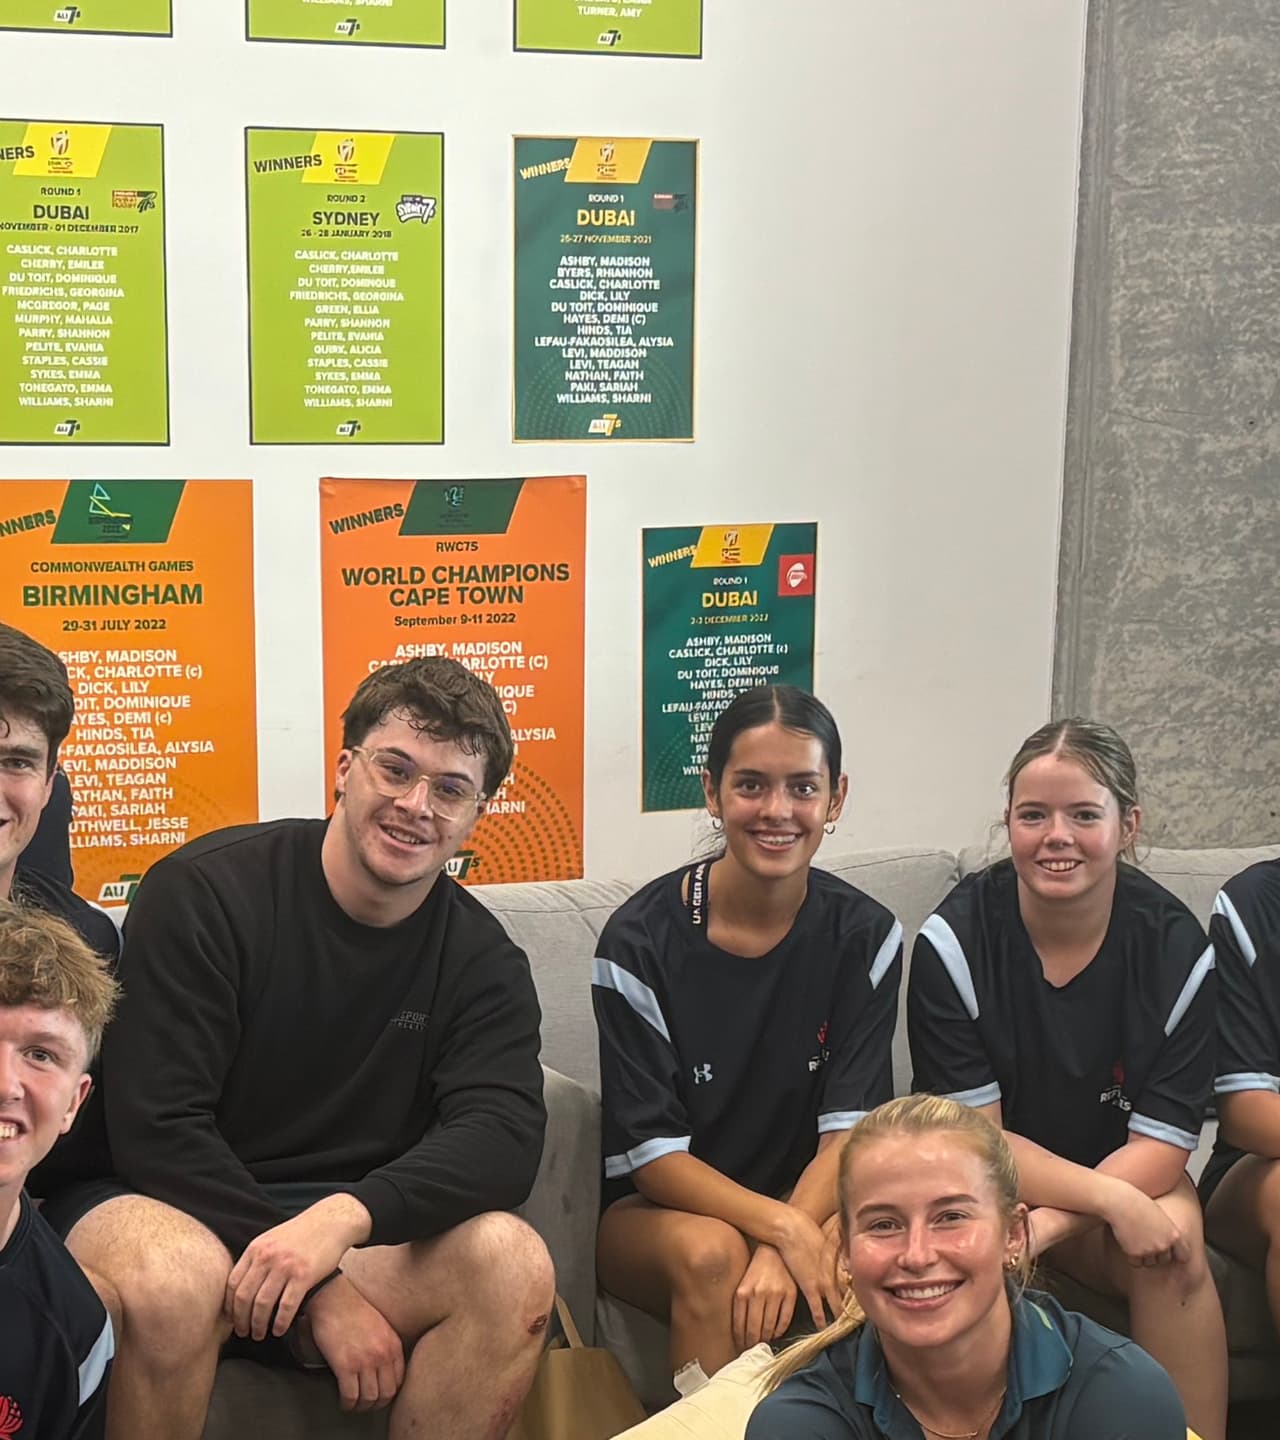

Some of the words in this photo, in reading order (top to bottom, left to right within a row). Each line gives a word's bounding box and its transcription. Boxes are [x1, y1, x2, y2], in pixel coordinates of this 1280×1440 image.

[578, 6, 618, 17] TURNER,
[620, 7, 642, 18] AMY
[253, 154, 322, 172] WINNERS
[519, 157, 571, 180] WINNERS
[33, 204, 89, 219] DUBAI
[312, 211, 379, 226] SYDNEY
[577, 209, 635, 226] DUBAI
[329, 503, 406, 535] WINNERS
[436, 540, 478, 552] RWC7S
[30, 560, 145, 572] COMMONWEALTH
[148, 560, 193, 571] GAMES
[341, 566, 425, 586] WORLD
[432, 563, 569, 584] CHAMPIONS
[23, 583, 202, 606] BIRMINGHAM
[389, 587, 449, 606] CAPE
[456, 585, 523, 604] TOWN
[702, 590, 757, 607] DUBAI
[62, 619, 97, 631] 29-31
[100, 619, 130, 630] JULY
[134, 618, 166, 629] 2022
[394, 615, 456, 628] September
[460, 613, 482, 624] 9-11
[485, 612, 516, 623] 2022
[106, 649, 176, 662] MADISON
[395, 643, 448, 657] ASHBY,
[452, 641, 522, 655] MADISON
[94, 664, 181, 678] CHARLOTTE
[185, 664, 202, 679] (c)
[77, 681, 117, 695] DICK,
[121, 680, 149, 693] LILY
[103, 695, 190, 709] DOMINIQUE
[75, 727, 126, 740] HINDS,
[130, 726, 154, 739] TIA
[164, 740, 214, 753] ALYSIA
[145, 816, 188, 830] JESSE
[129, 831, 185, 845] SHARNI
